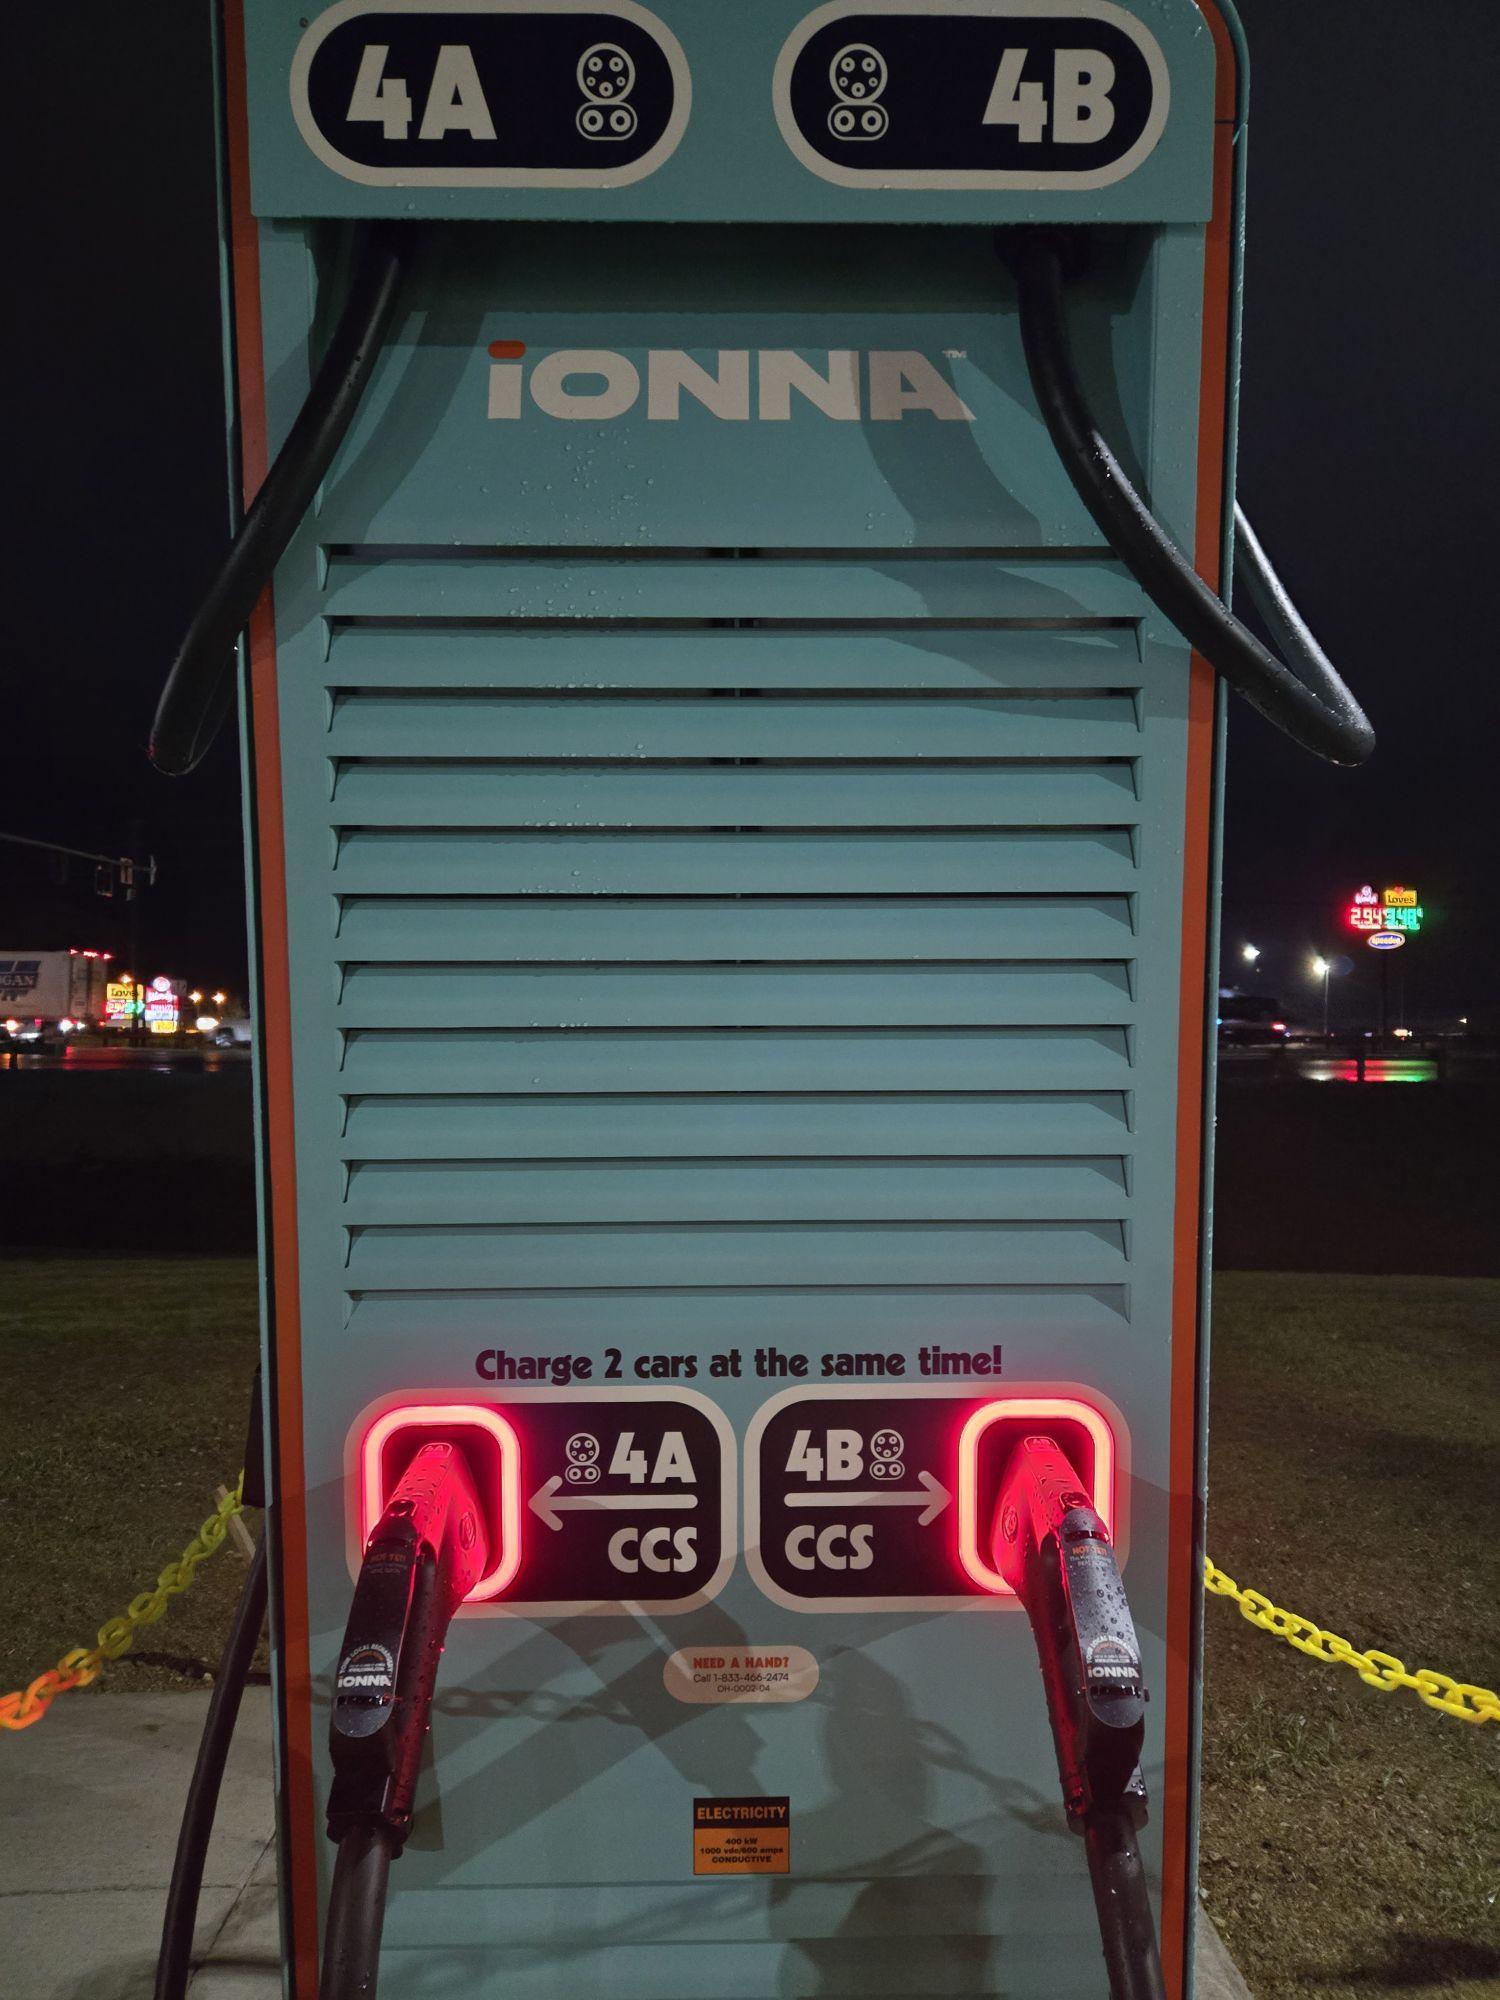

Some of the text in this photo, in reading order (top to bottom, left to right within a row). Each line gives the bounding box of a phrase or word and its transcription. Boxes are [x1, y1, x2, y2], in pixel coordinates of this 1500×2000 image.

[346, 45, 497, 139] 4A
[982, 48, 1115, 143] 4B
[475, 1345, 1002, 1386] Charge 2 cars at the same time!
[608, 1431, 697, 1484] 4A
[785, 1429, 864, 1481] 4B
[608, 1526, 698, 1573] CCS
[785, 1524, 874, 1570] CCS
[693, 1656, 790, 1669] NEED A HAND?
[693, 1672, 789, 1683] Call 1-833-466-2474
[697, 1806, 786, 1820] ELECTRICITY
[700, 1847, 721, 1855] 1000
[760, 1847, 784, 1855] amps
[712, 1855, 772, 1864] CONDUCTIVE
[744, 1837, 758, 1845] kW
